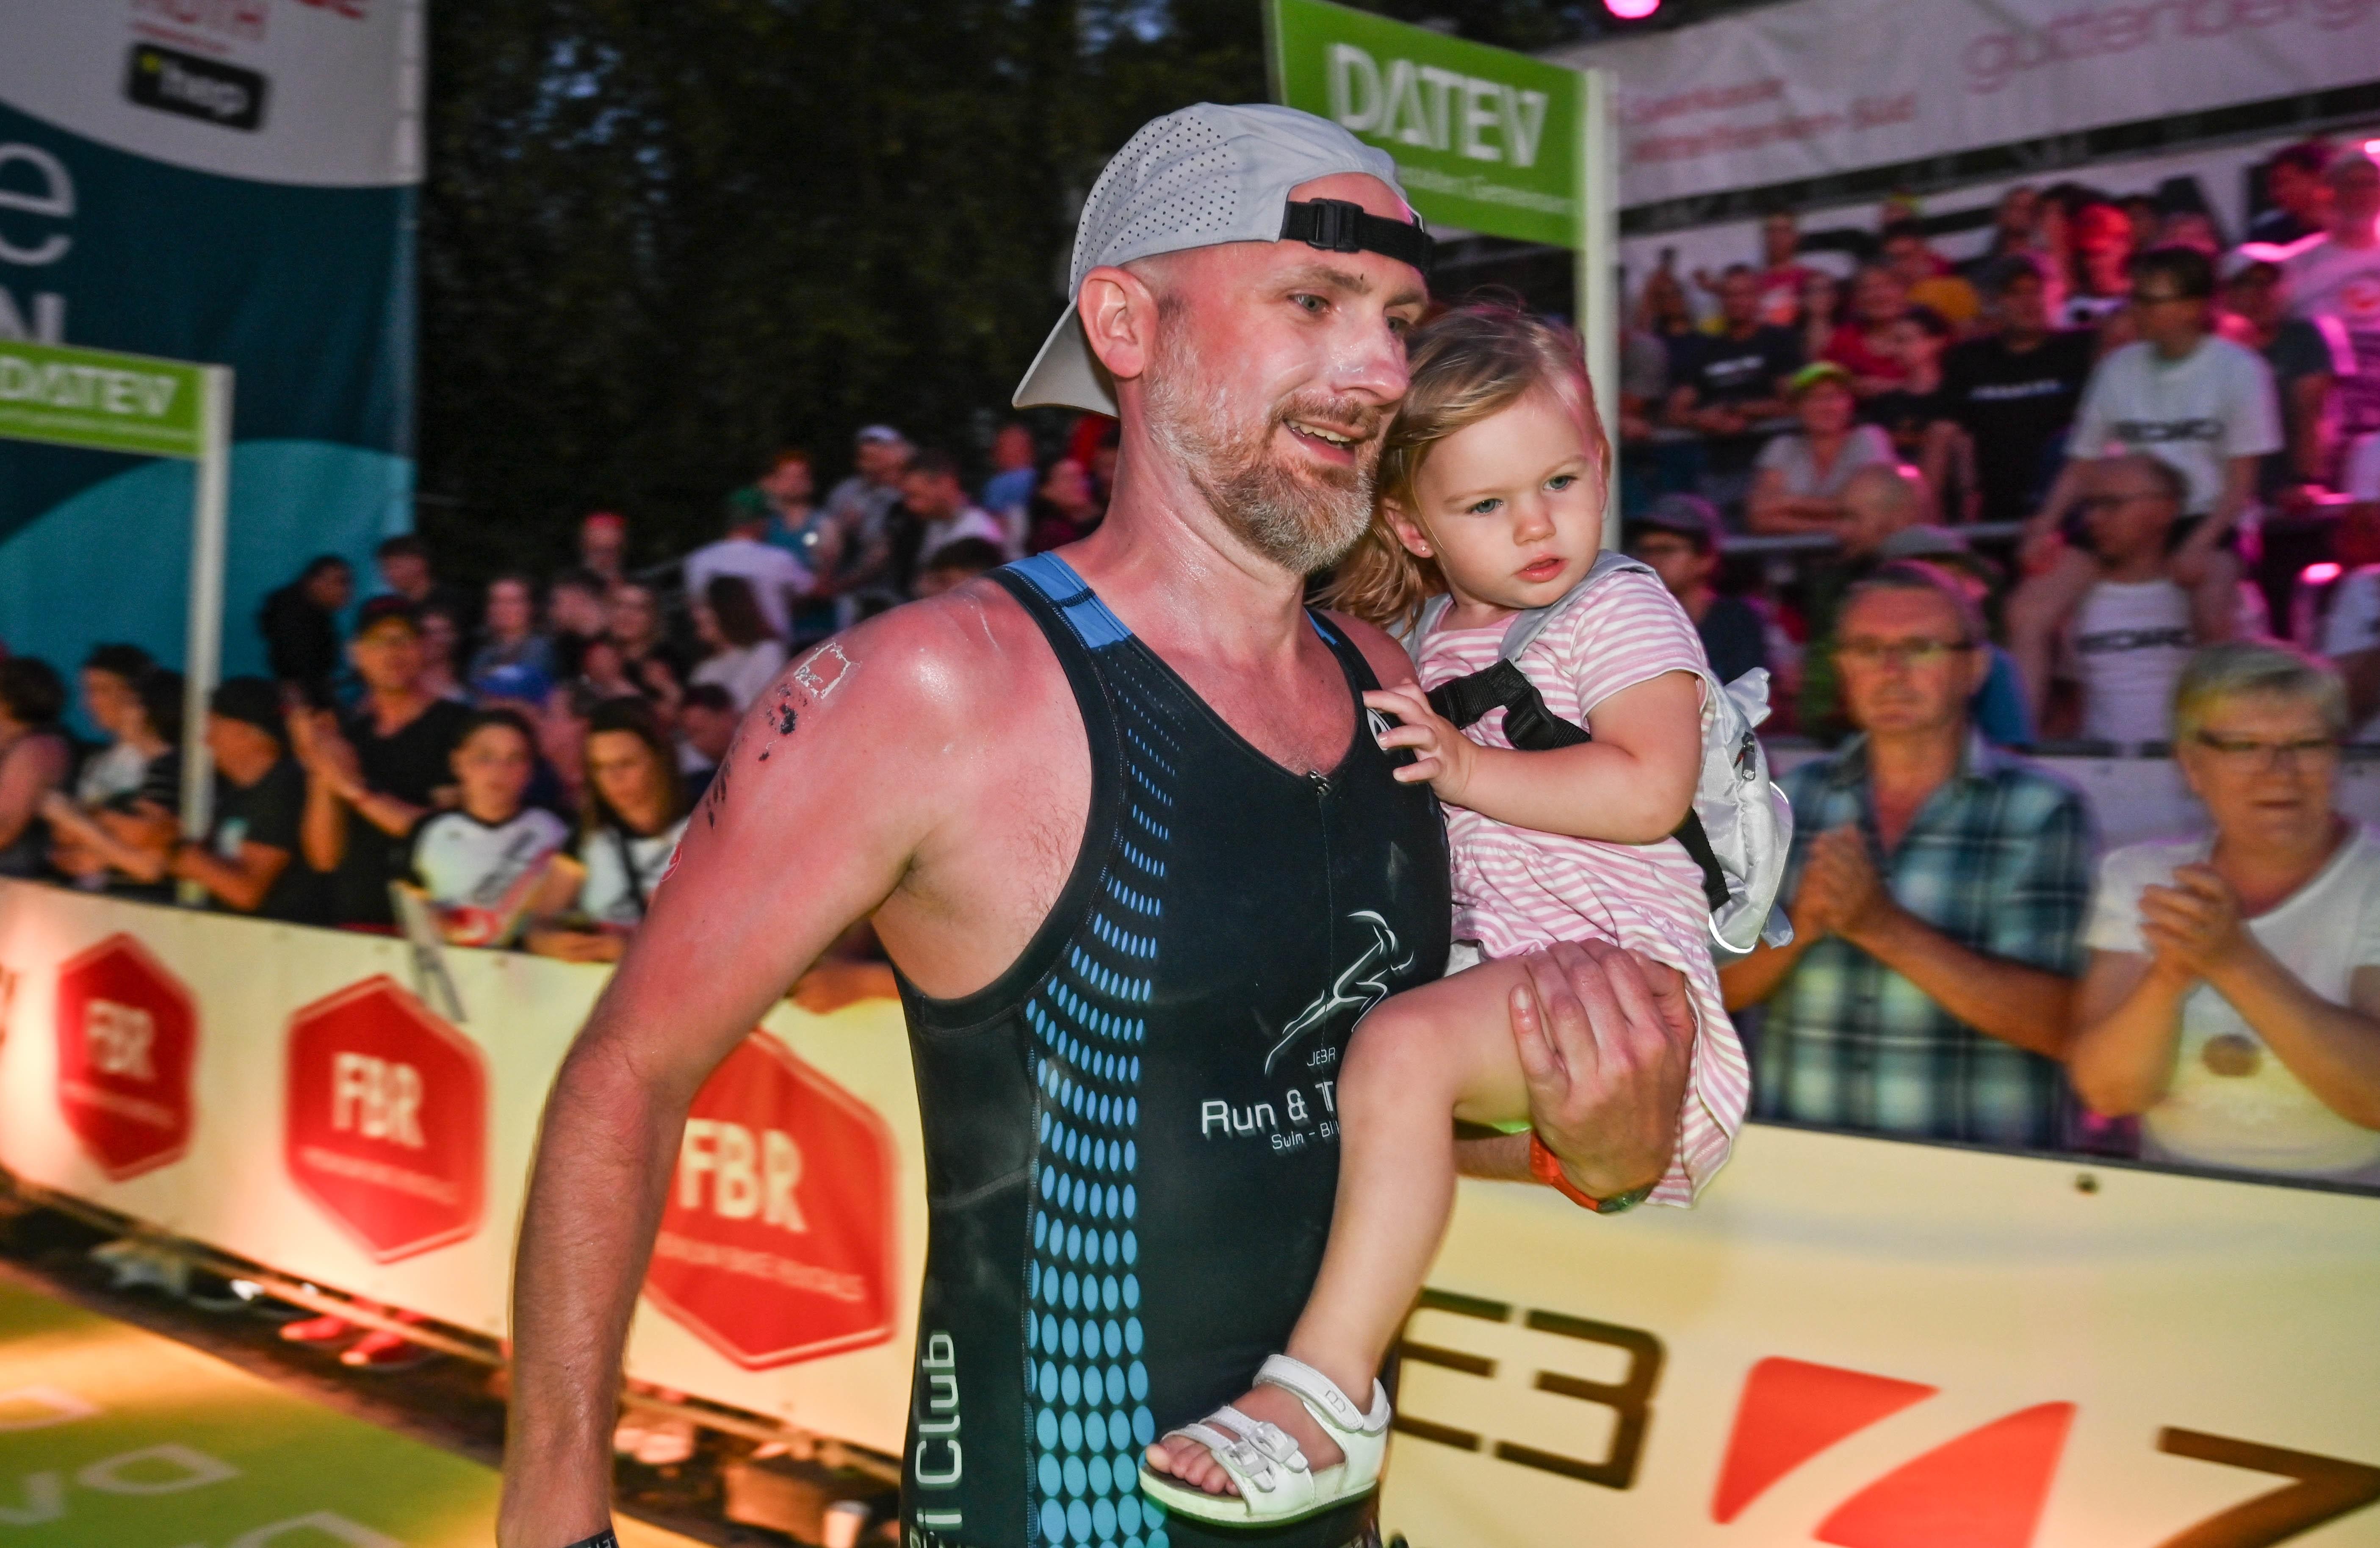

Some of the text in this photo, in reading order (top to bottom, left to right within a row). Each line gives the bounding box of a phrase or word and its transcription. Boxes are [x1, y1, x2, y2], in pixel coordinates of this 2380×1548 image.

[1331, 43, 1549, 167] DATEV
[0, 357, 180, 417] DATEV
[87, 1000, 158, 1081] FBR
[332, 1052, 424, 1149] FBR
[1202, 1080, 1334, 1134] Run & T
[1271, 1131, 1304, 1150] Swim
[678, 1118, 808, 1233] FBR
[915, 1334, 962, 1484] Club
[1393, 1285, 1668, 1491] E3
